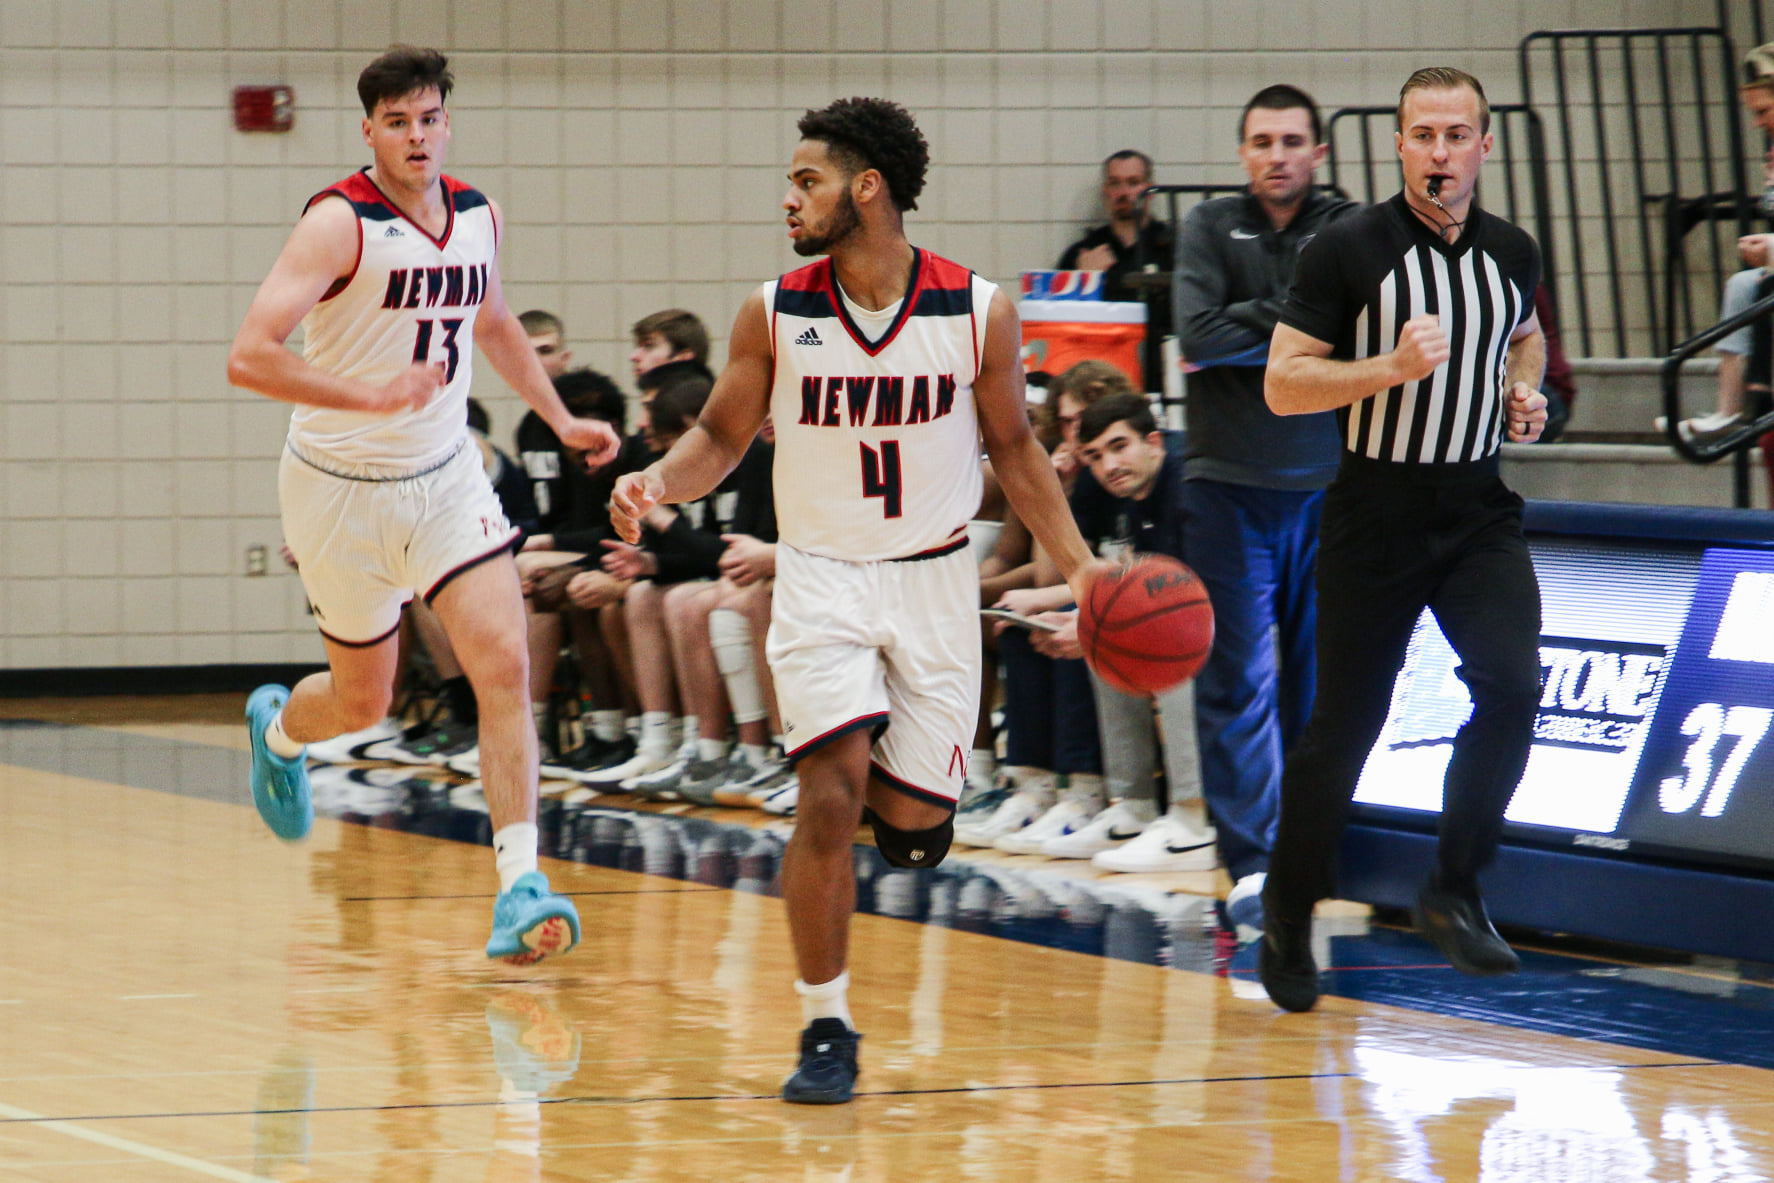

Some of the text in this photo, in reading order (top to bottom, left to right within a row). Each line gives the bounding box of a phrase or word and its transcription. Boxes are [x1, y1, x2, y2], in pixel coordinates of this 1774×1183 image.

[411, 318, 465, 386] 13
[798, 373, 957, 427] NEWMAN
[859, 440, 902, 519] 4
[1538, 646, 1665, 717] TONE
[1658, 702, 1774, 818] 37
